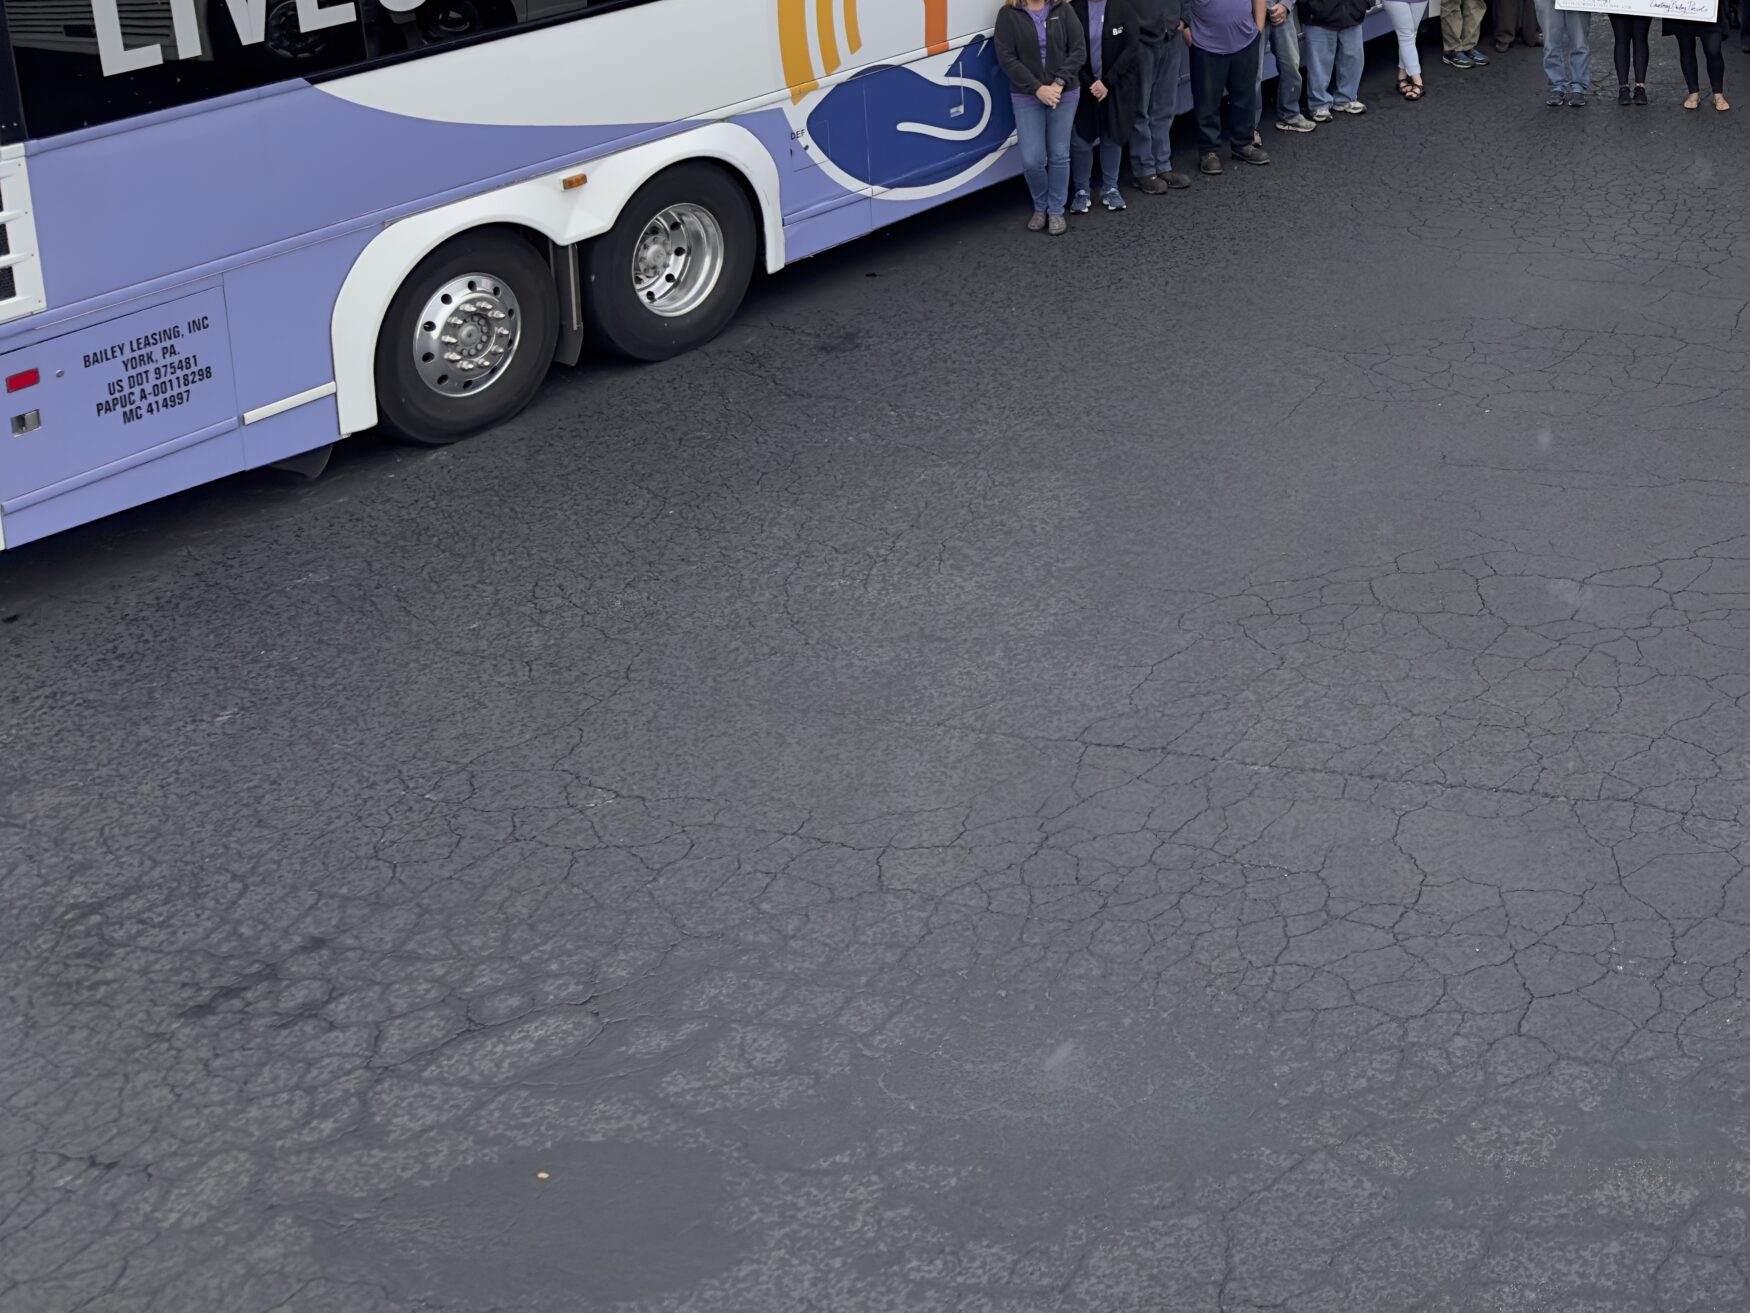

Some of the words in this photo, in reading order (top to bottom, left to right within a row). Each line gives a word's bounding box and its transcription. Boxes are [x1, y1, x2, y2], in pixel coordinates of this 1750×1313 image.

[790, 129, 805, 140] DEF
[83, 343, 125, 368] BAILEY
[129, 325, 184, 353] LEASING,
[187, 315, 209, 334] INC
[122, 351, 158, 372] YORK,
[162, 344, 180, 359] PA.
[96, 391, 136, 416] PAPUC
[140, 366, 212, 402] A-00118298
[108, 379, 124, 396] US
[128, 370, 150, 389] DOT
[154, 354, 198, 380] 975481
[122, 406, 143, 424] MC
[146, 389, 191, 415] 414997
